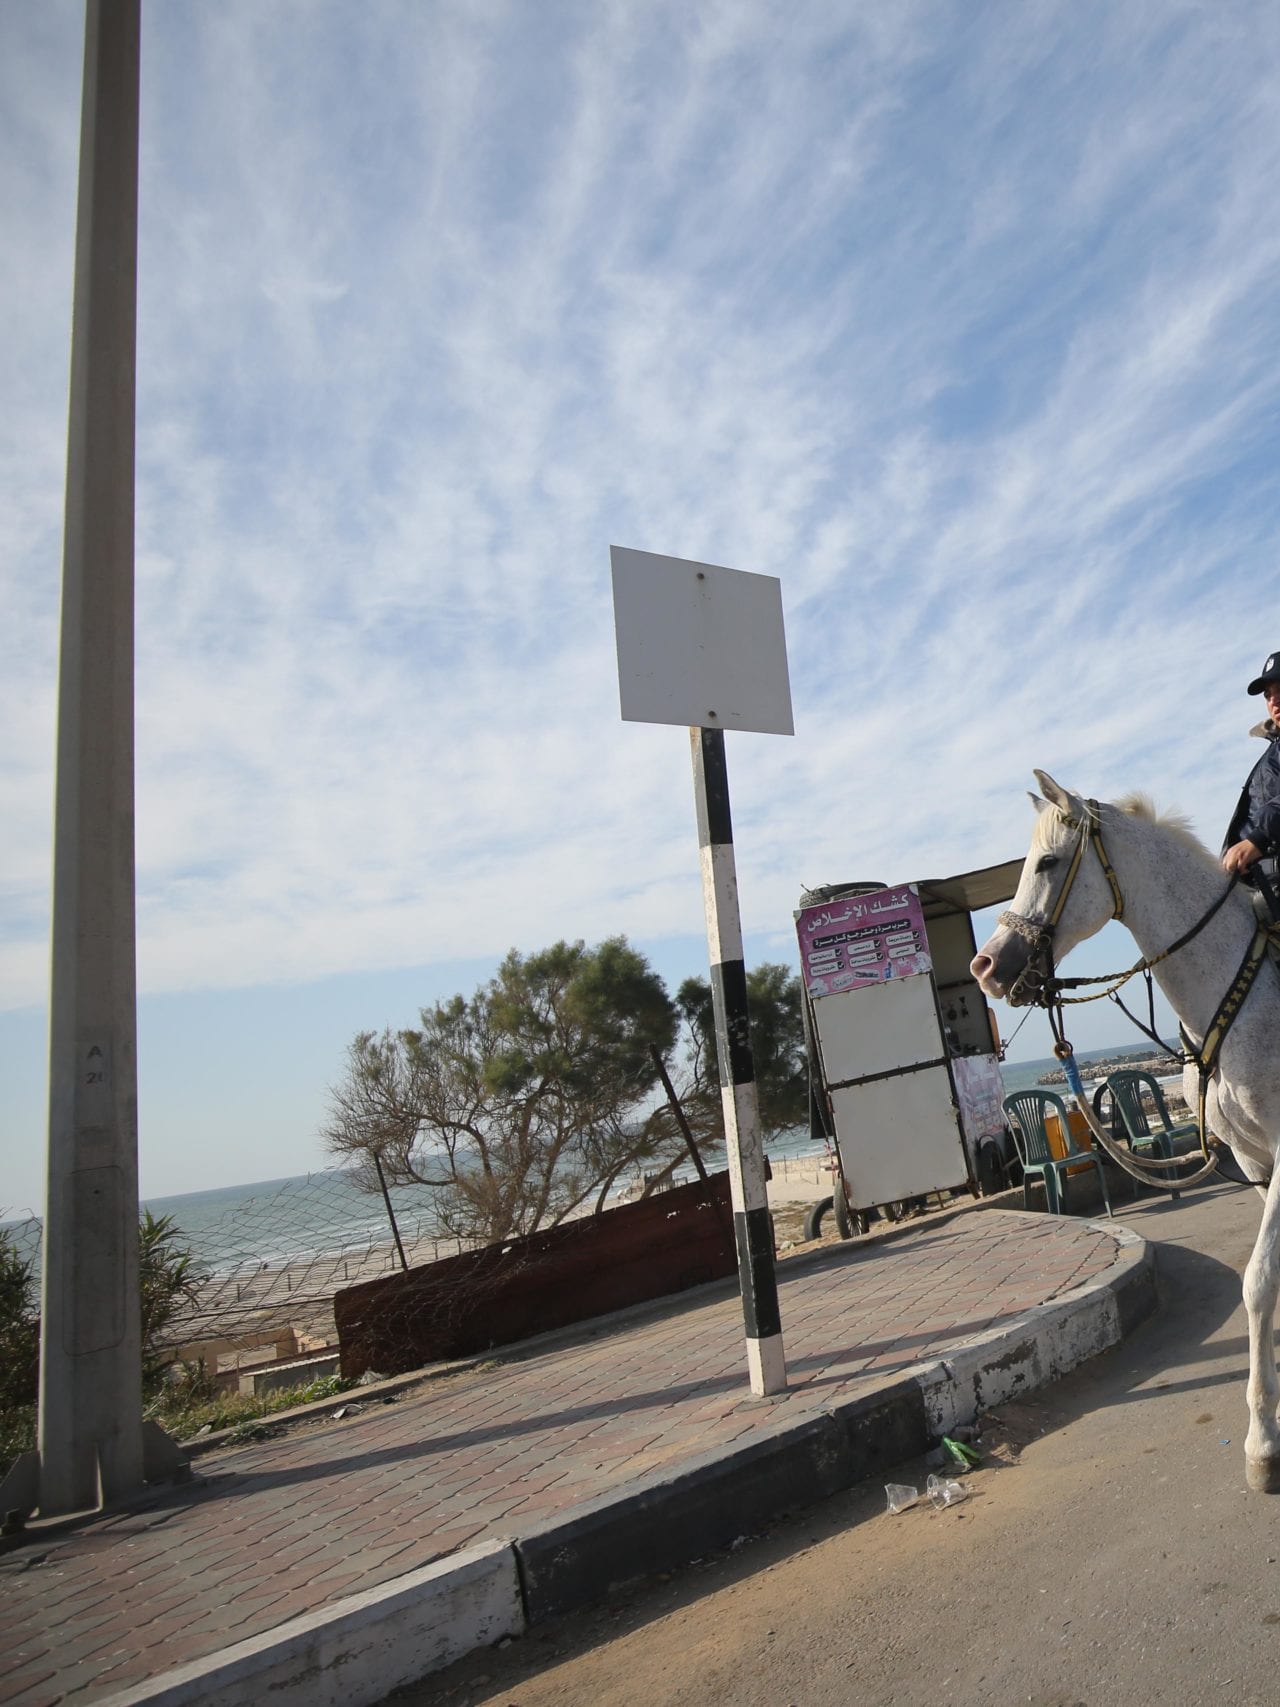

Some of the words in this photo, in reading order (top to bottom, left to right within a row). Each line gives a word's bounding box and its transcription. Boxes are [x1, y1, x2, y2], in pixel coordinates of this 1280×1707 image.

[870, 894, 908, 914] كشك
[807, 904, 868, 931] الإخلاص
[814, 938, 833, 947] مرة
[87, 1045, 103, 1058] A
